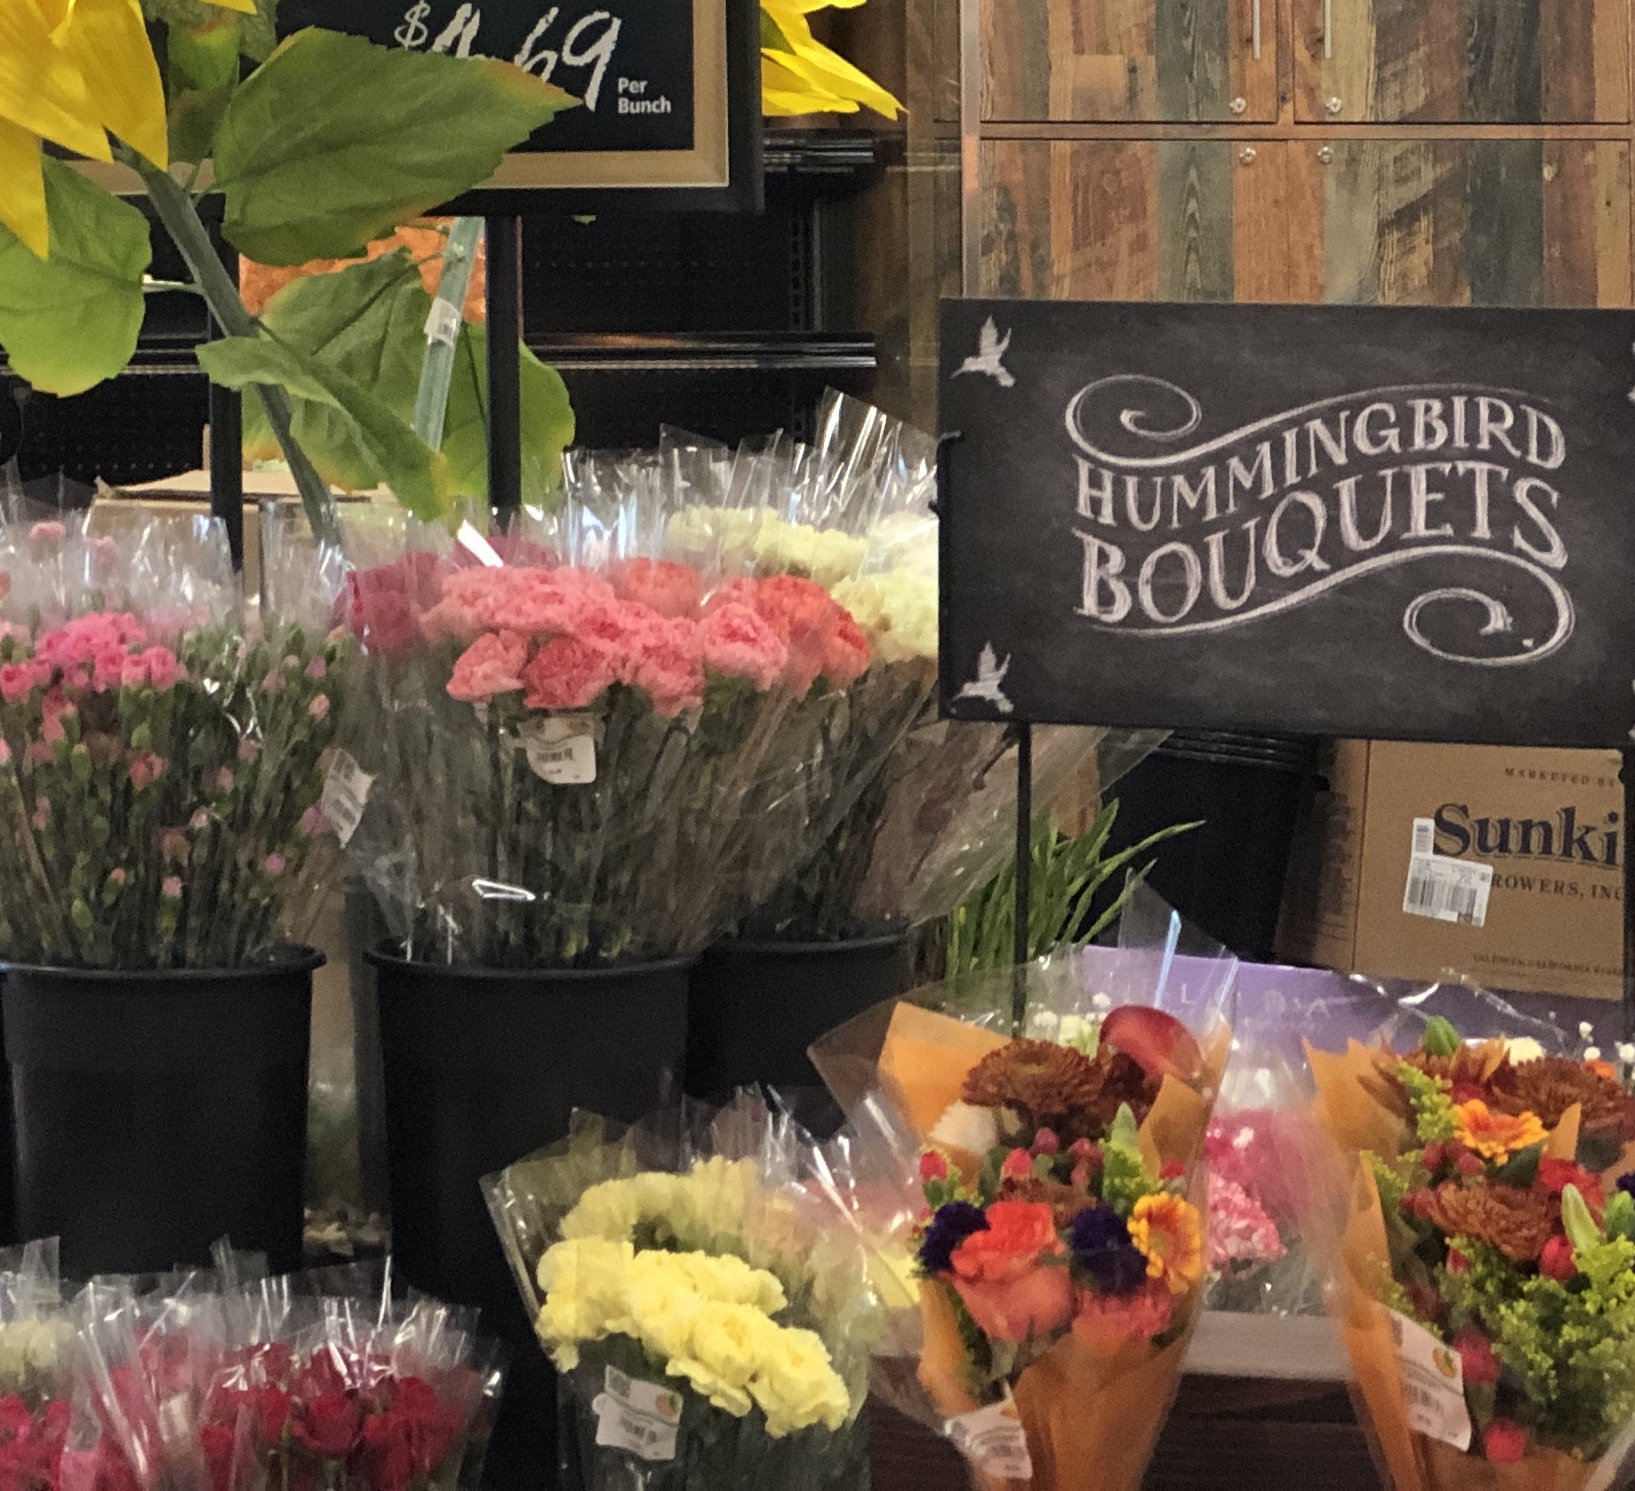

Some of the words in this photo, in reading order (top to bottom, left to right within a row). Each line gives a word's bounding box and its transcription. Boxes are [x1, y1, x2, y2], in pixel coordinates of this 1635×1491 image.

[618, 77, 648, 94] Per
[618, 95, 671, 114] Bunch
[1073, 395, 1566, 532] HUMMINGBIRD
[1071, 460, 1568, 624] BOUQUETS
